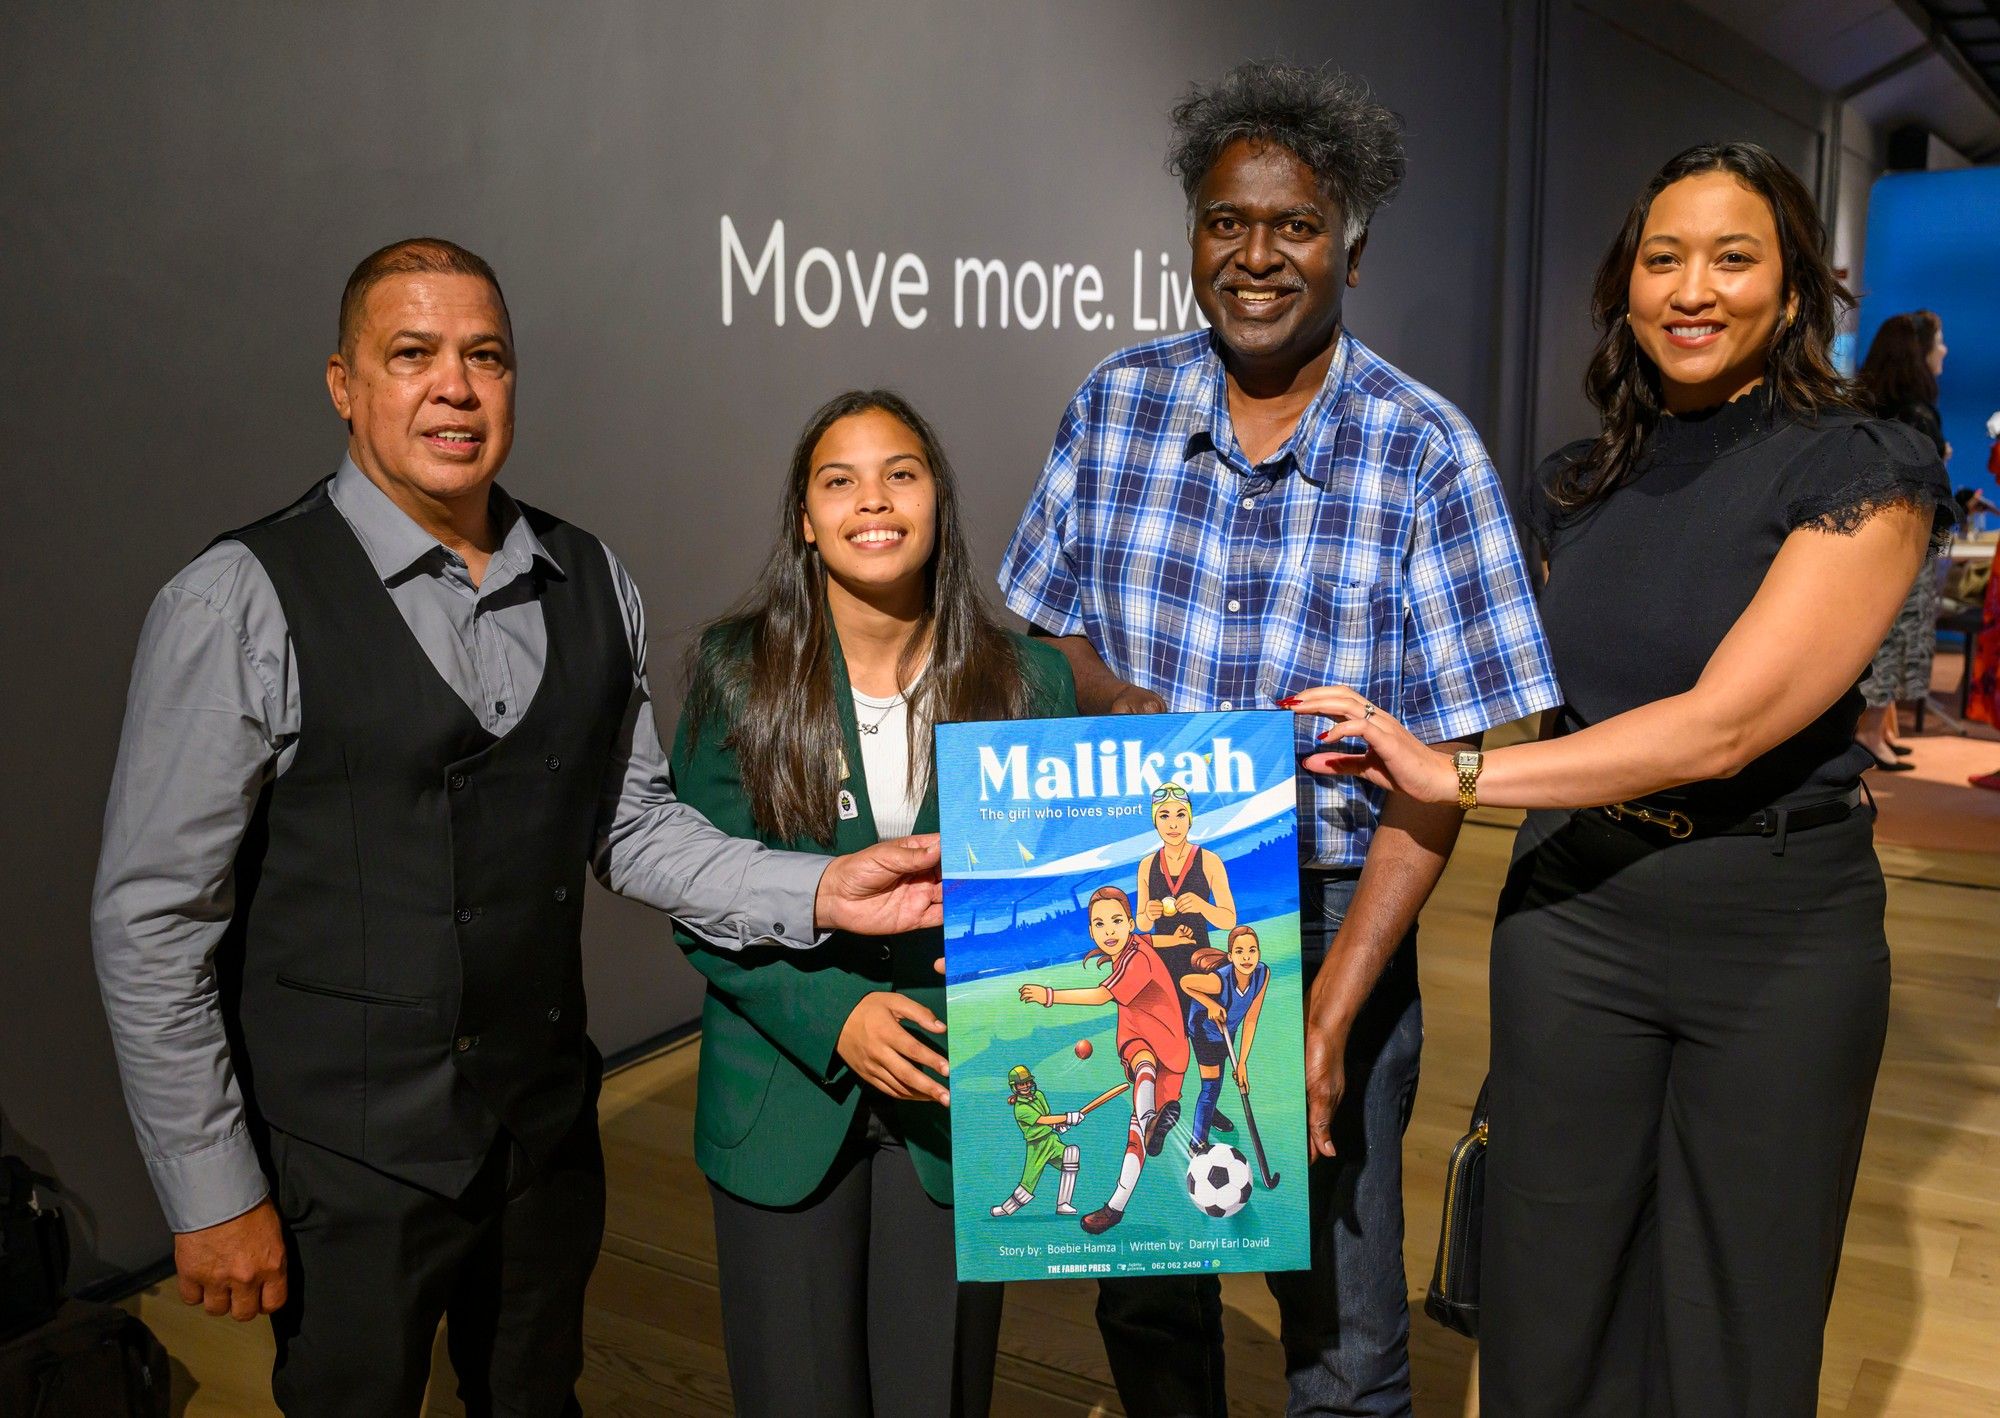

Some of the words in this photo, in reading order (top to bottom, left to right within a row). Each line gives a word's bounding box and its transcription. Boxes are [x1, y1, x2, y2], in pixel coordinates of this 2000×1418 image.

[720, 214, 929, 329] Move
[954, 256, 1115, 331] more.
[978, 737, 1256, 802] Malikah
[979, 808, 1005, 820] The
[1008, 807, 1031, 823] girl
[1035, 806, 1063, 819] who
[1067, 805, 1103, 818] loves
[1107, 803, 1143, 818] sport
[999, 1245, 1025, 1257] Story
[1027, 1244, 1042, 1257] by:
[1047, 1243, 1081, 1254] Boebie
[1083, 1243, 1116, 1254] Hamza
[1129, 1240, 1166, 1252] Written
[1169, 1240, 1184, 1252] by:
[1189, 1238, 1219, 1251] Darryl
[1221, 1237, 1240, 1249] Earl
[1243, 1237, 1270, 1248] David
[1047, 1265, 1061, 1274] THE
[1061, 1264, 1088, 1274] FABRIC
[1088, 1263, 1111, 1273] PRESS
[1151, 1262, 1165, 1270] 062
[1167, 1261, 1181, 1269] 062
[1183, 1261, 1202, 1269] 2450
